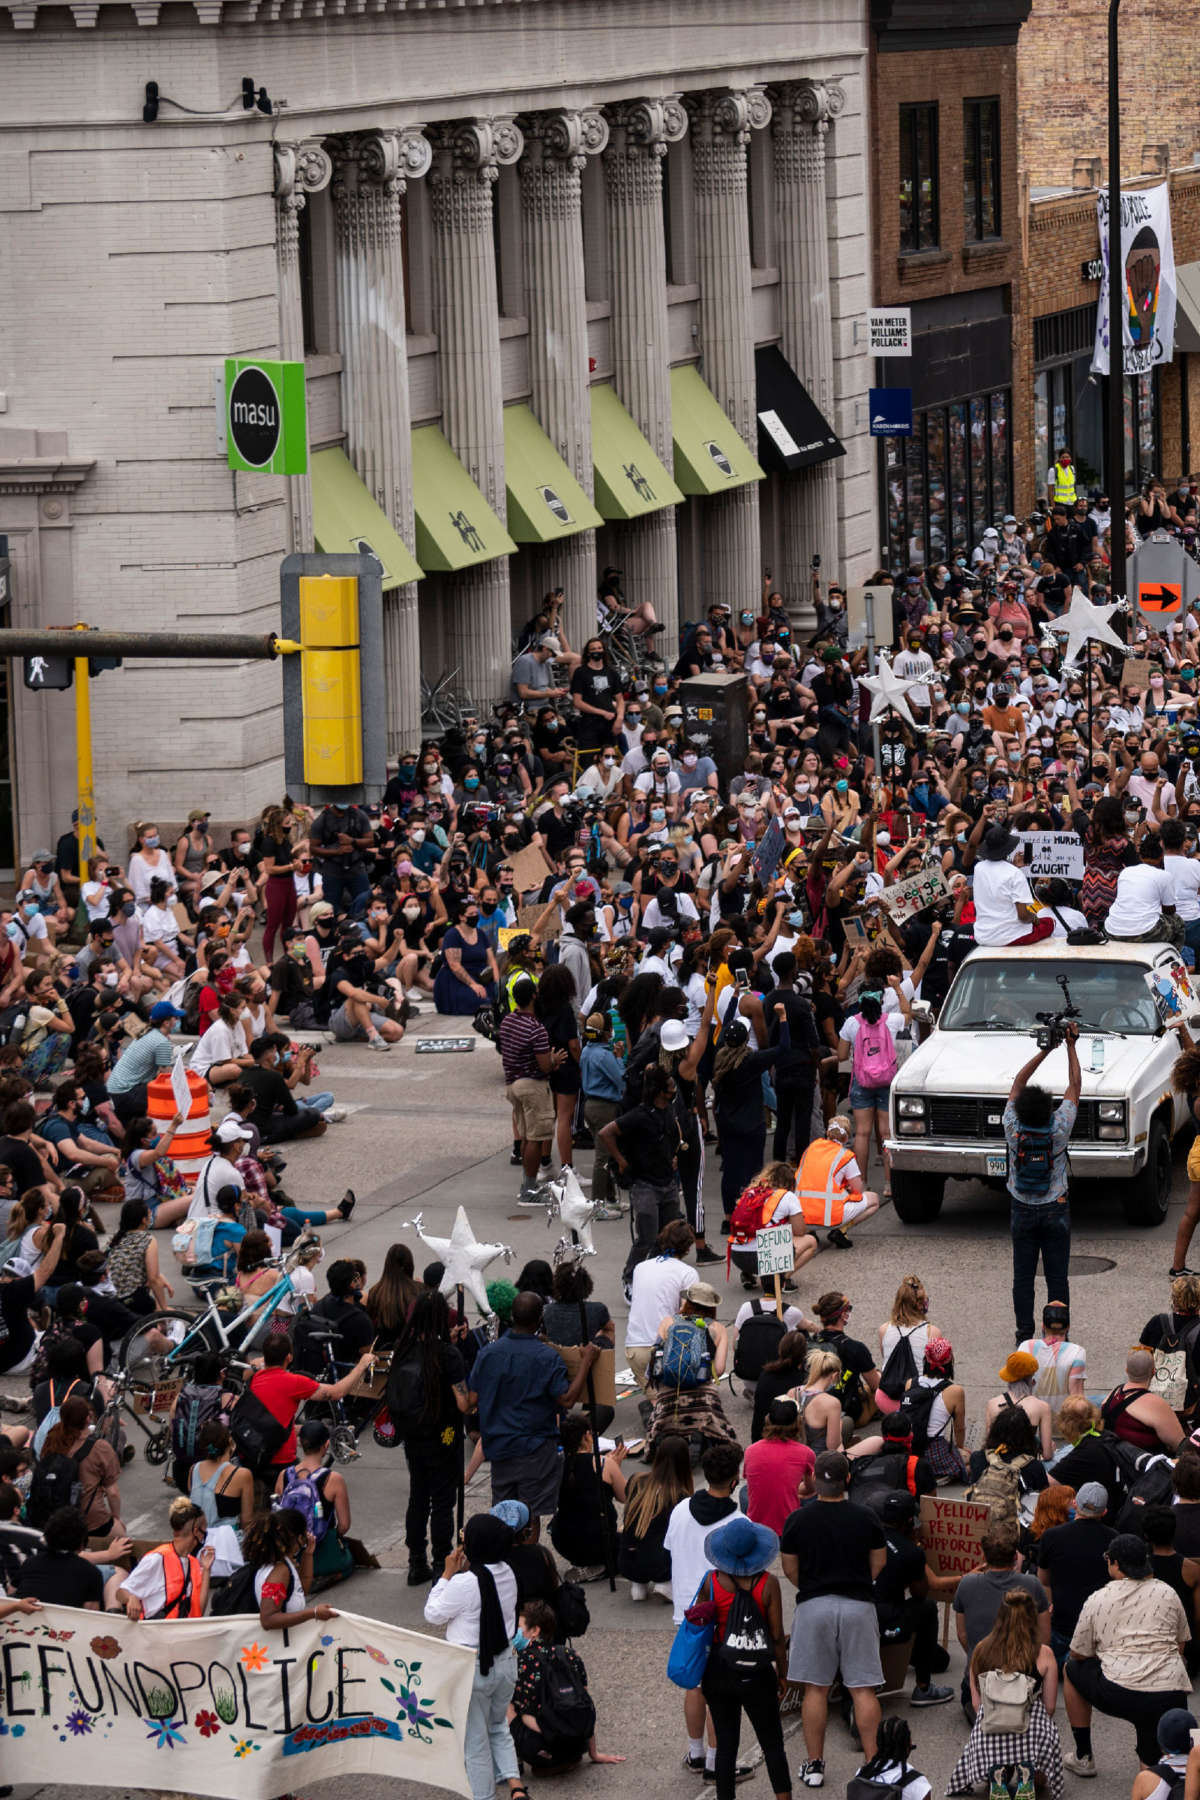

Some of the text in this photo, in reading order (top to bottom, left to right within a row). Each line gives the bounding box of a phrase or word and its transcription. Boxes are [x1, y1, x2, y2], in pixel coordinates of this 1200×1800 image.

[871, 318, 907, 327] VAN METER
[871, 328, 907, 337] WILLIAMS
[234, 402, 276, 426] masu
[1031, 864, 1070, 875] CAUGHT
[896, 878, 939, 908] george
[912, 884, 947, 910] floyd
[758, 1229, 791, 1249] DEFUND
[759, 1249, 772, 1259] THE
[933, 1502, 988, 1522] YELLOW
[929, 1520, 974, 1538] PERIL
[921, 1535, 983, 1558] SUPPORTS
[938, 1555, 982, 1574] BLACK
